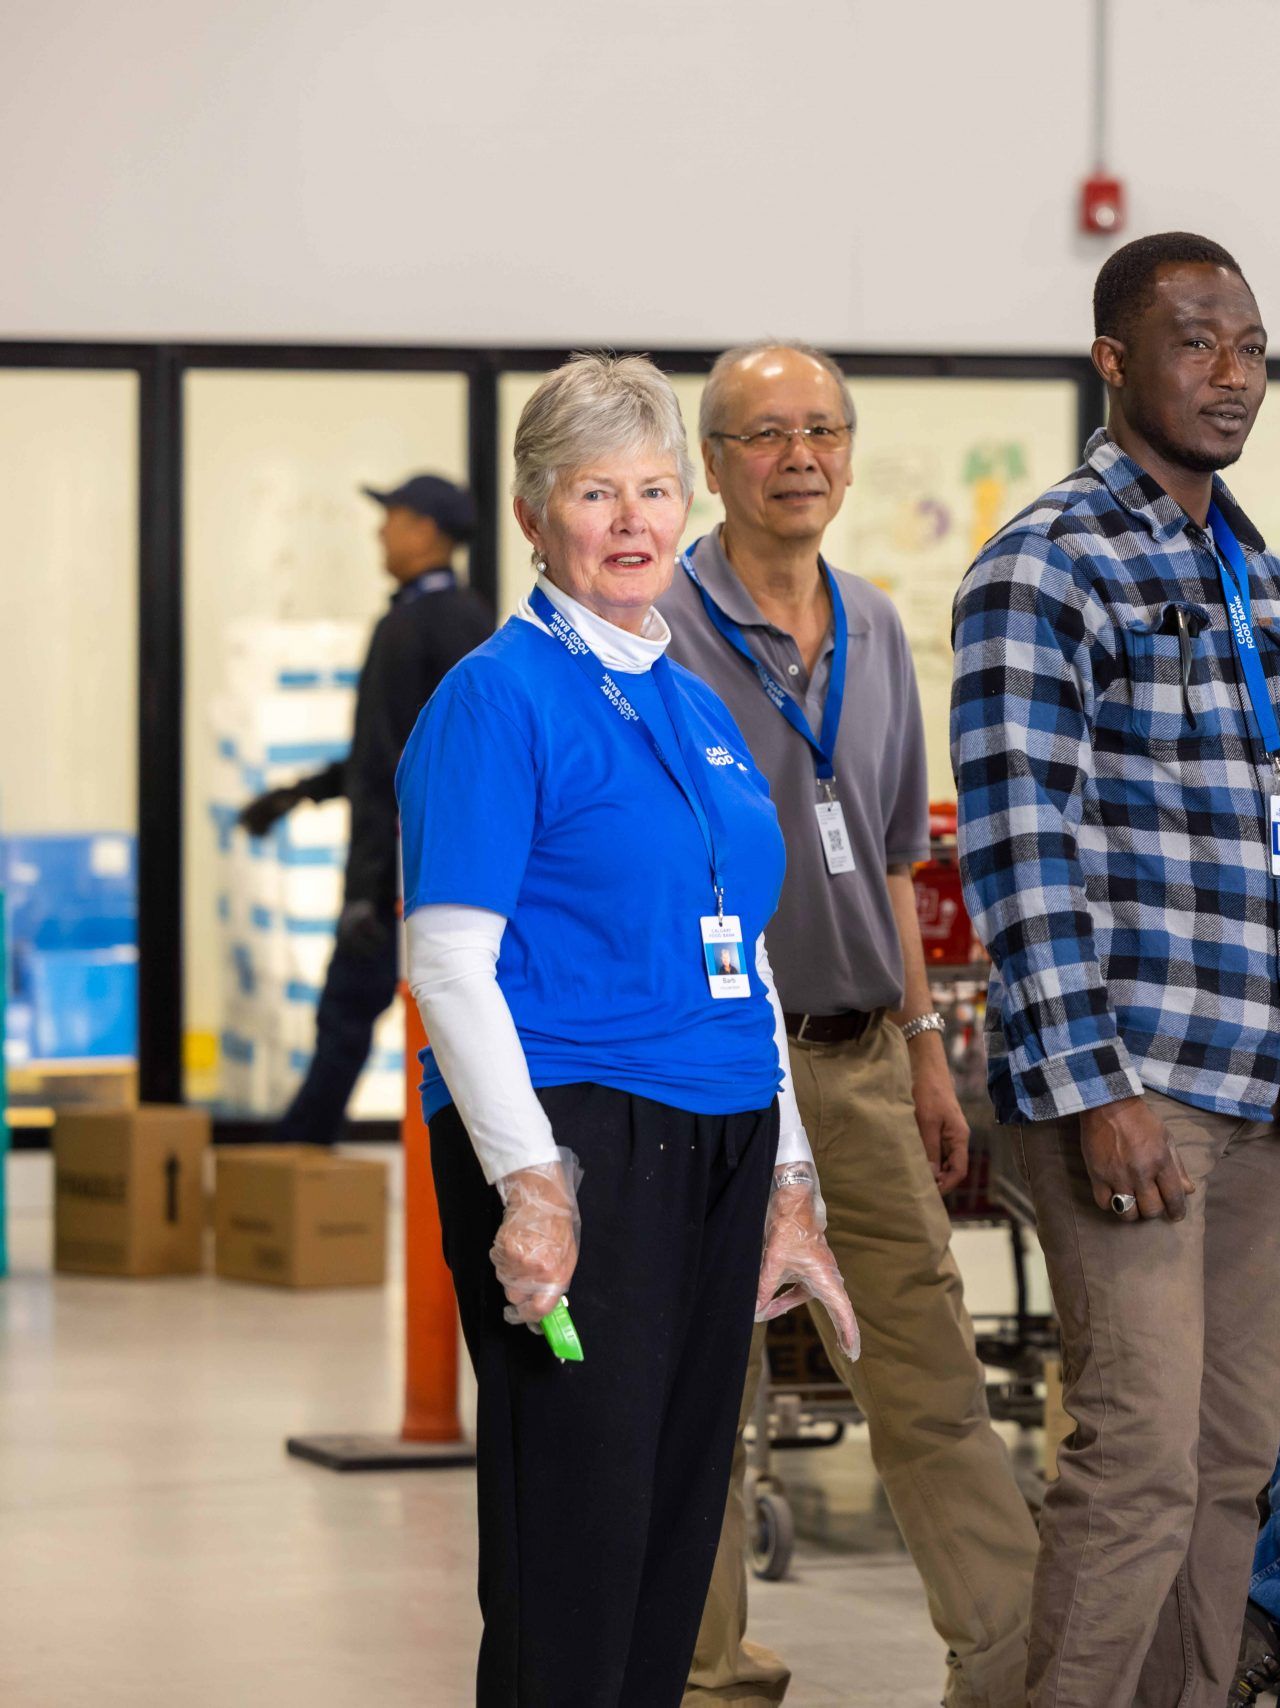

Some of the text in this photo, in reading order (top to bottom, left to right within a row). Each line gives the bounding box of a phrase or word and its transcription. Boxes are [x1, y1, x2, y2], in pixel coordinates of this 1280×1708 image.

[549, 622, 578, 655] CALGARY
[551, 611, 590, 655] FOOD BANK
[1229, 602, 1245, 645] CALGARY
[1234, 595, 1255, 649] FOOD BANK
[600, 684, 630, 720] CALGARY
[602, 673, 639, 721] FOOD BANK
[706, 755, 734, 766] FOOD
